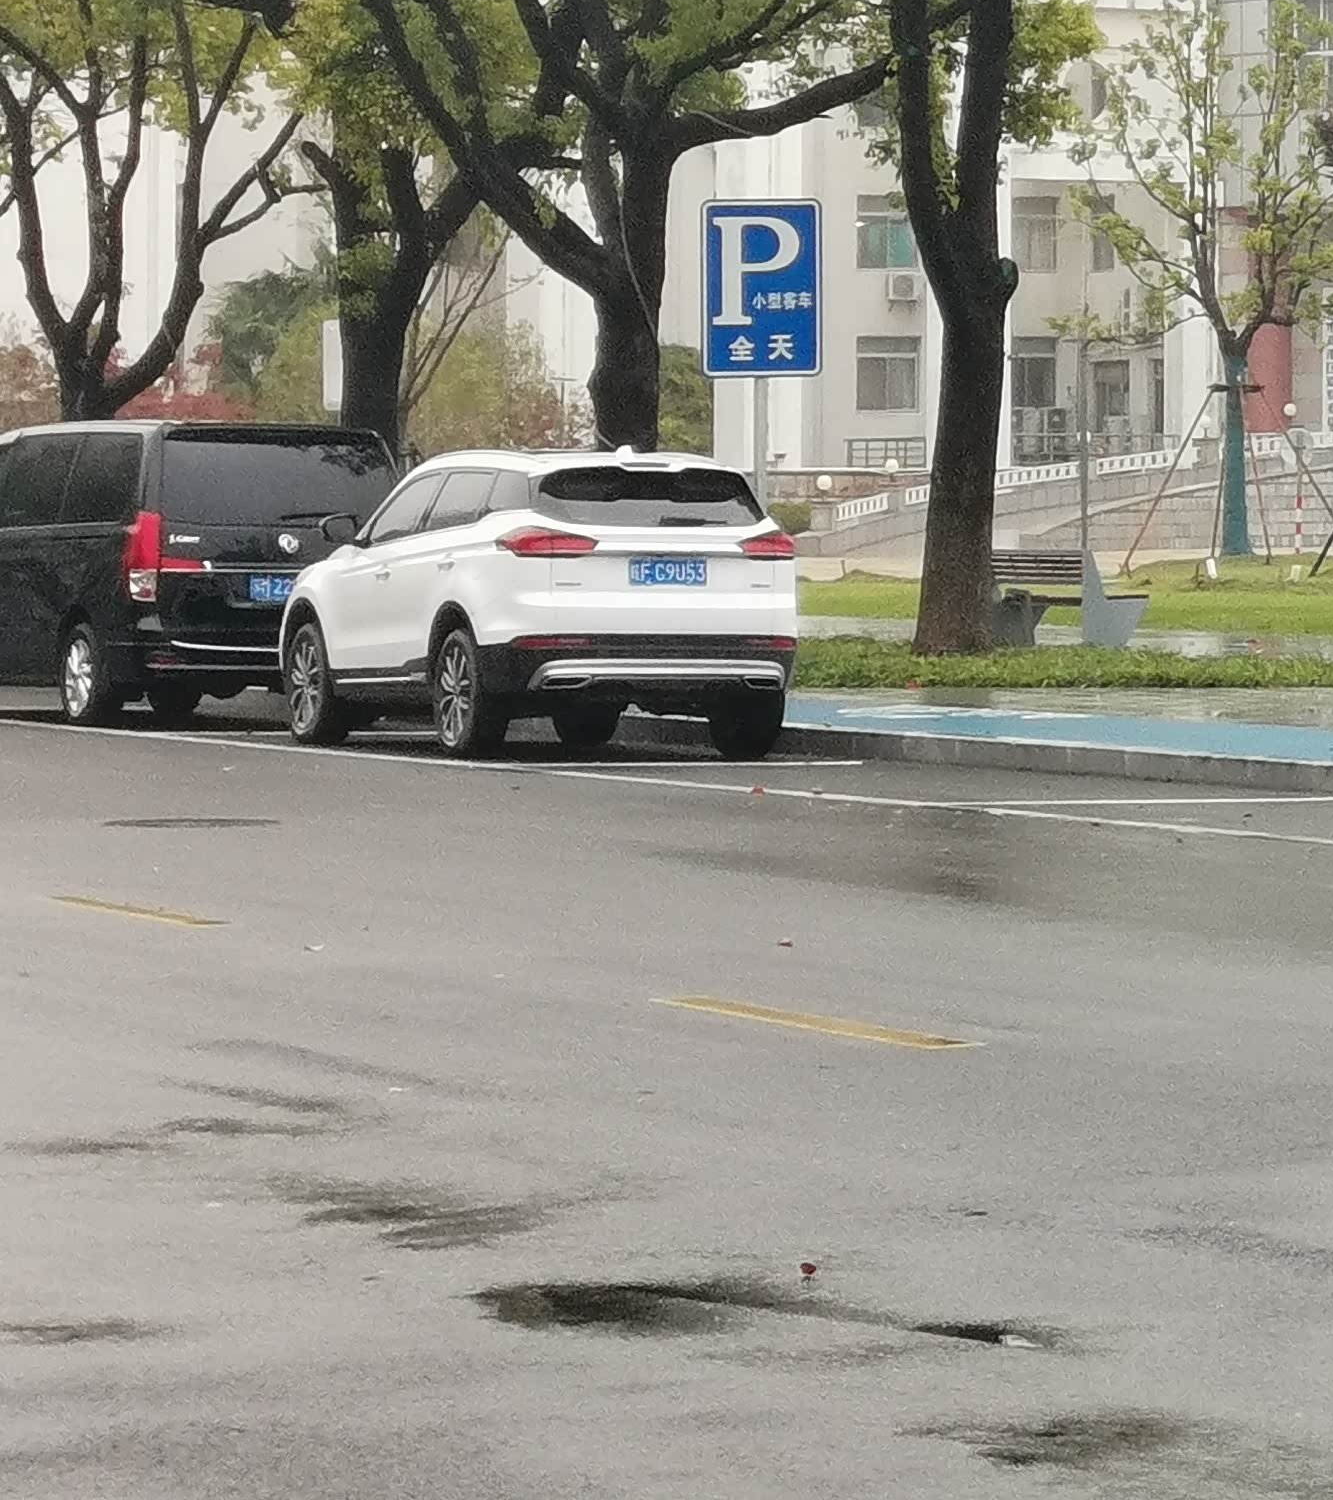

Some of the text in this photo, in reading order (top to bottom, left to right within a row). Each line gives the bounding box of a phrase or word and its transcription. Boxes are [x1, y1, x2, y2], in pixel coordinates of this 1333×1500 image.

[712, 216, 800, 326] P
[751, 291, 813, 310] 小型客车
[728, 333, 794, 361] 全天
